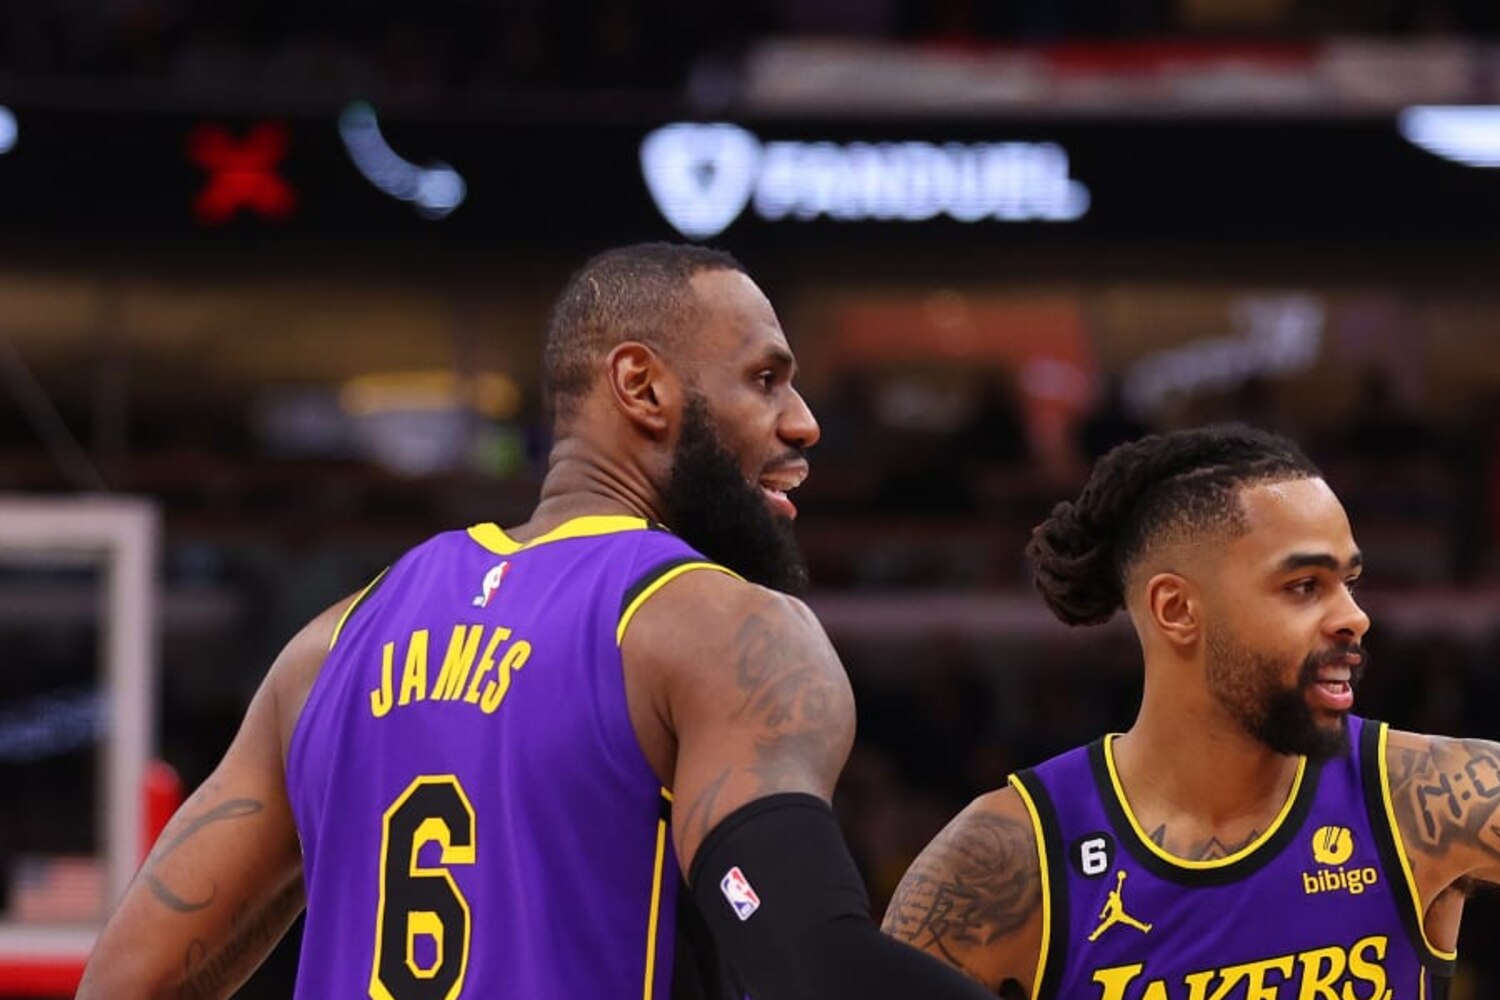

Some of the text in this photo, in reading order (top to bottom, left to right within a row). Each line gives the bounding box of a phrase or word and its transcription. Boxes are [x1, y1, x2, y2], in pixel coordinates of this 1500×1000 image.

[370, 624, 532, 718] JAMES
[1081, 837, 1108, 875] 6
[1302, 866, 1378, 895] bibigo
